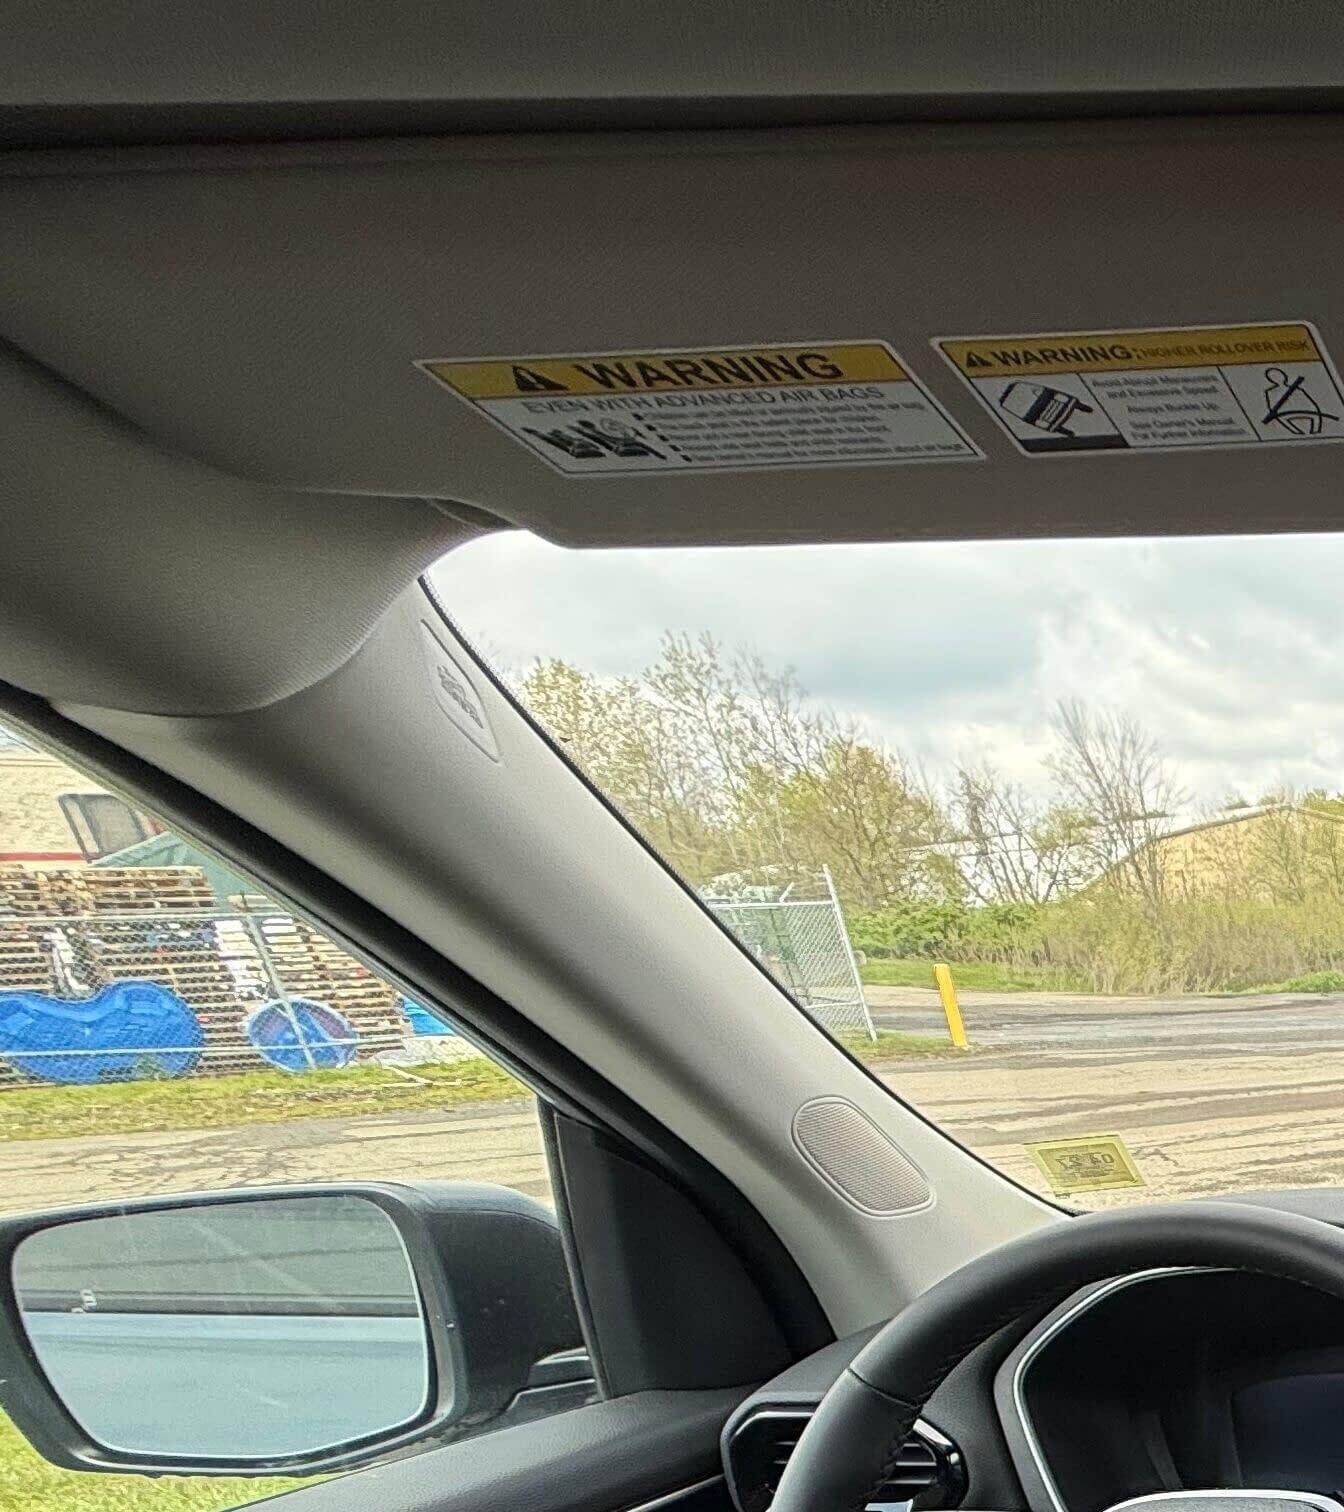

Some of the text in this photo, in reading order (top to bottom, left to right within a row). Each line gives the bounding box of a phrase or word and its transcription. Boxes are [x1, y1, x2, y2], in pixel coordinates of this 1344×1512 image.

[993, 345, 1141, 366] WARNING:
[576, 353, 843, 389] WARNING
[522, 386, 881, 413] EVEN WITH ADVANCED AIR BAGS
